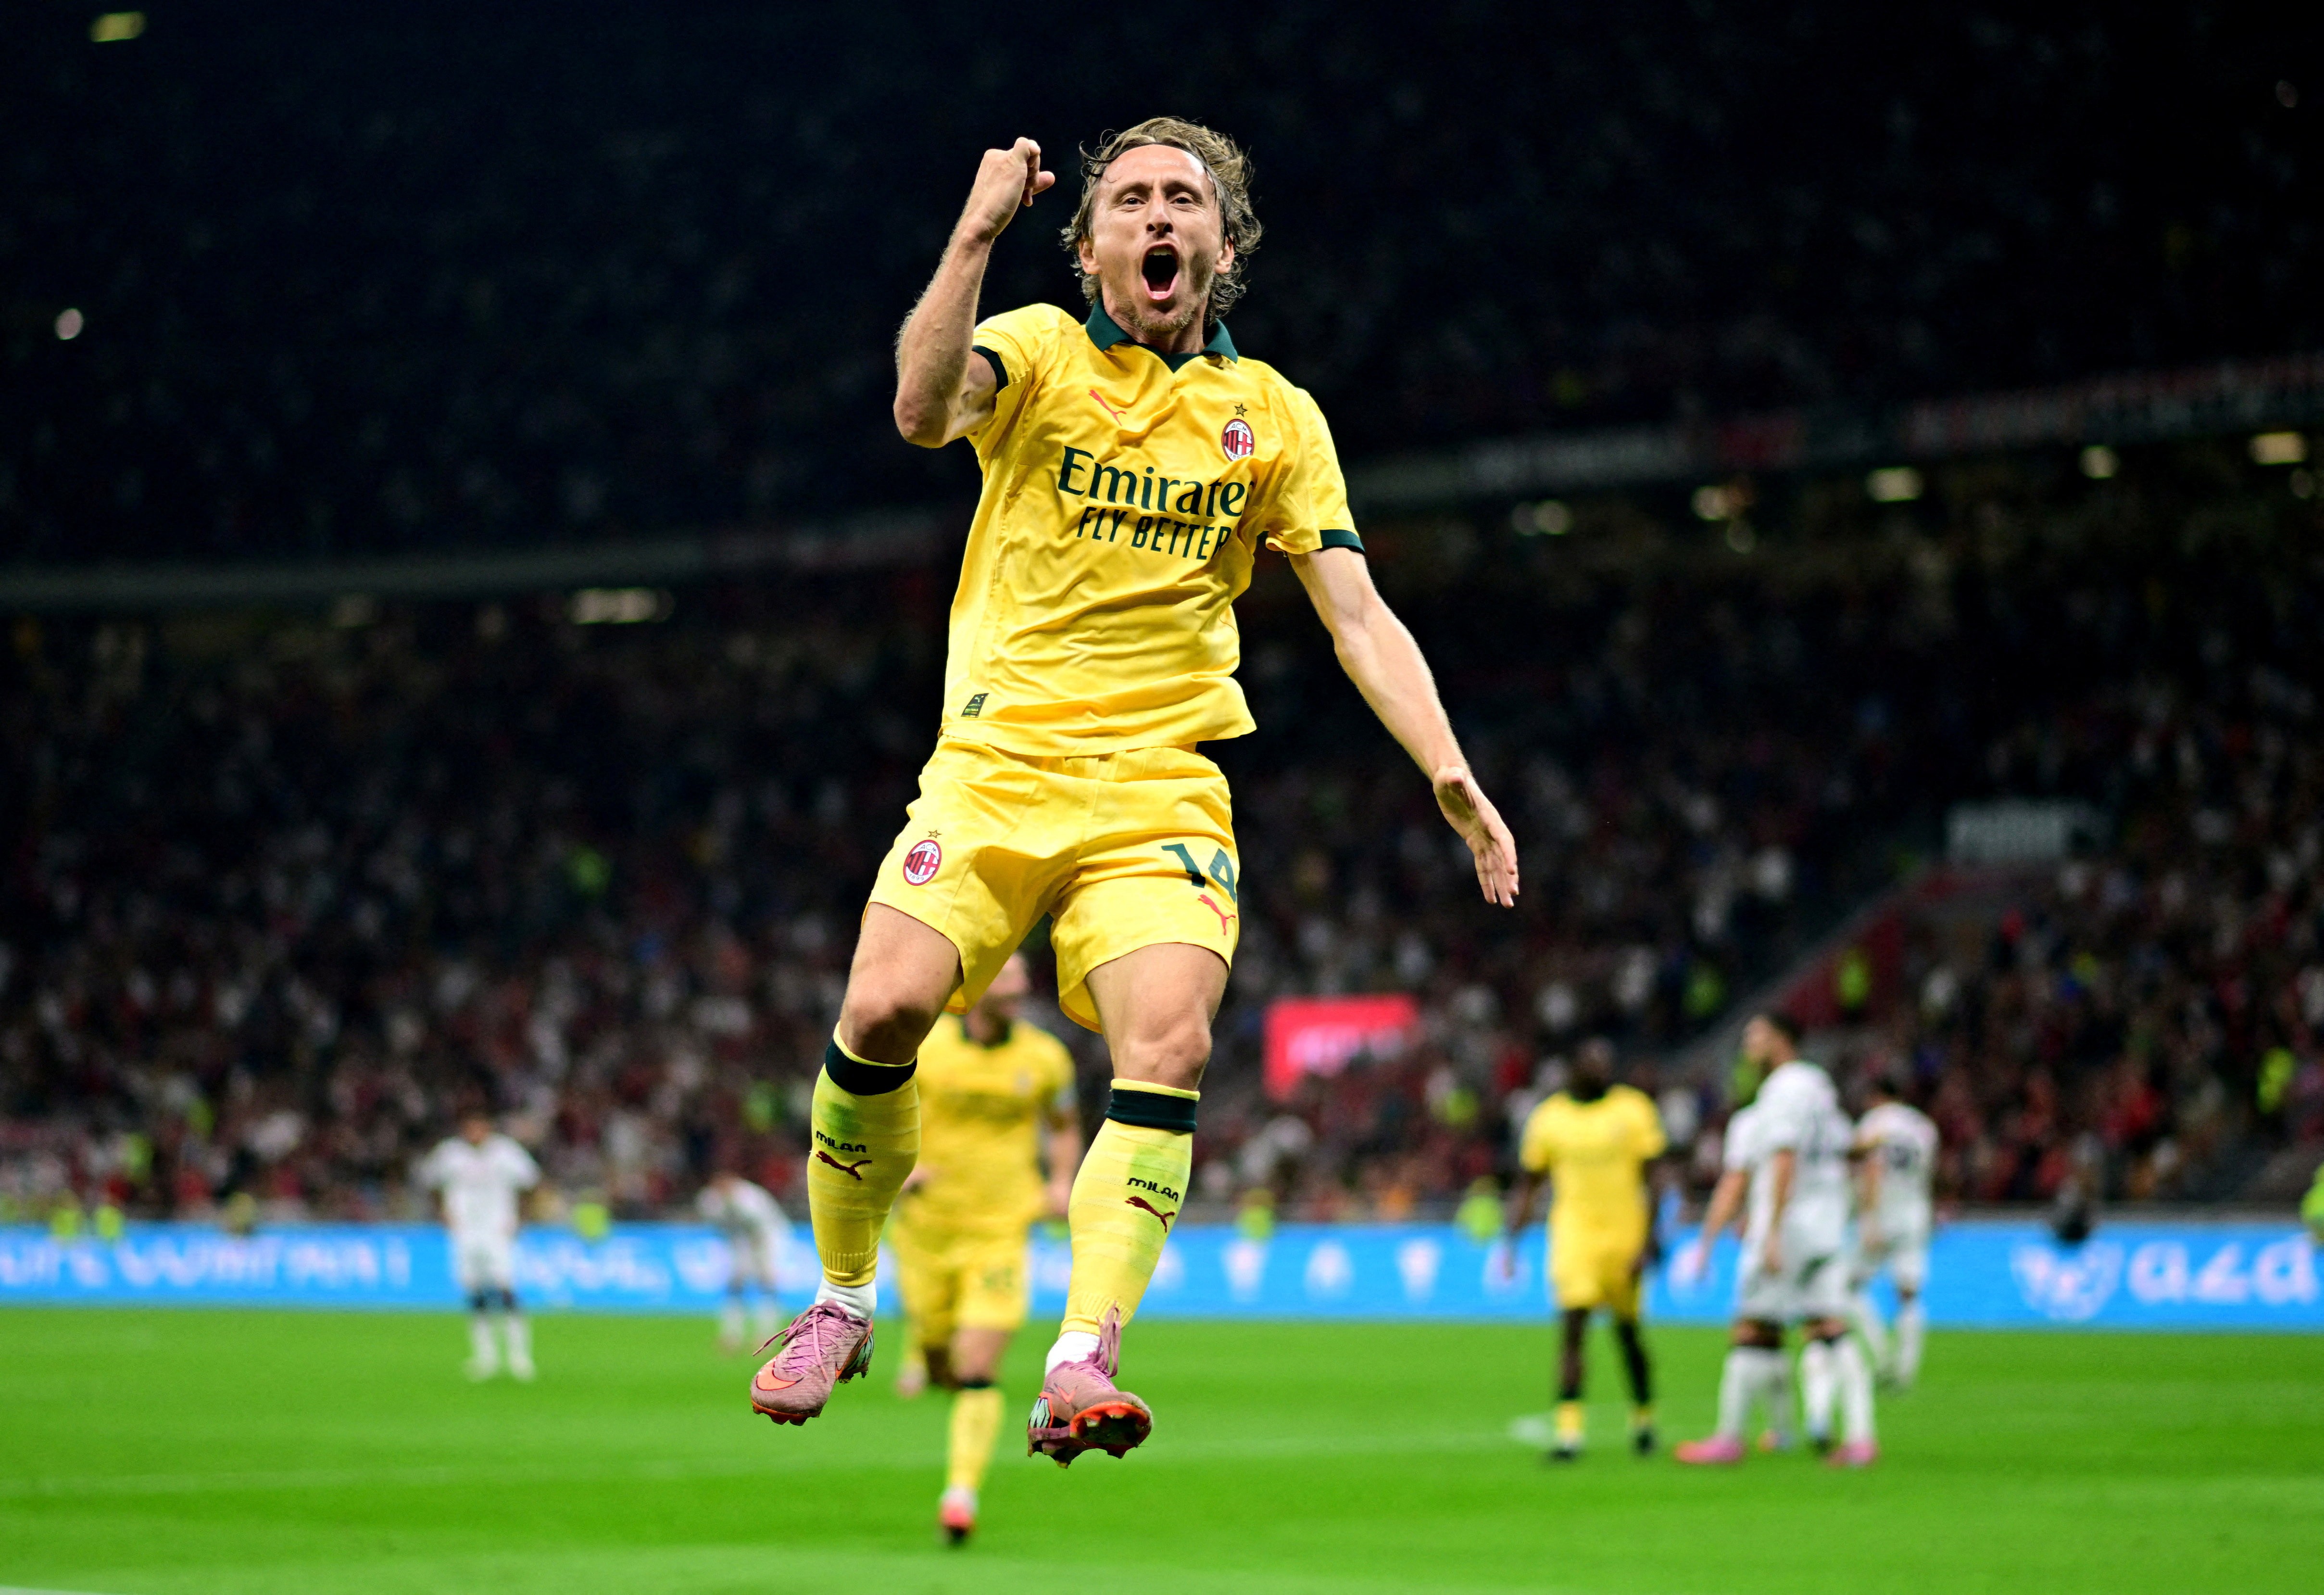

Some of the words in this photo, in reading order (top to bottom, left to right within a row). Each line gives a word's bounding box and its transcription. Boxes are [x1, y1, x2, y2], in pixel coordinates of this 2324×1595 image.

[1230, 423, 1248, 434] ACM
[1057, 445, 1255, 517] Emirate
[1077, 506, 1128, 543] FLY
[1131, 516, 1232, 560] BETTER
[918, 844, 937, 855] ACM
[1161, 843, 1237, 904] 14
